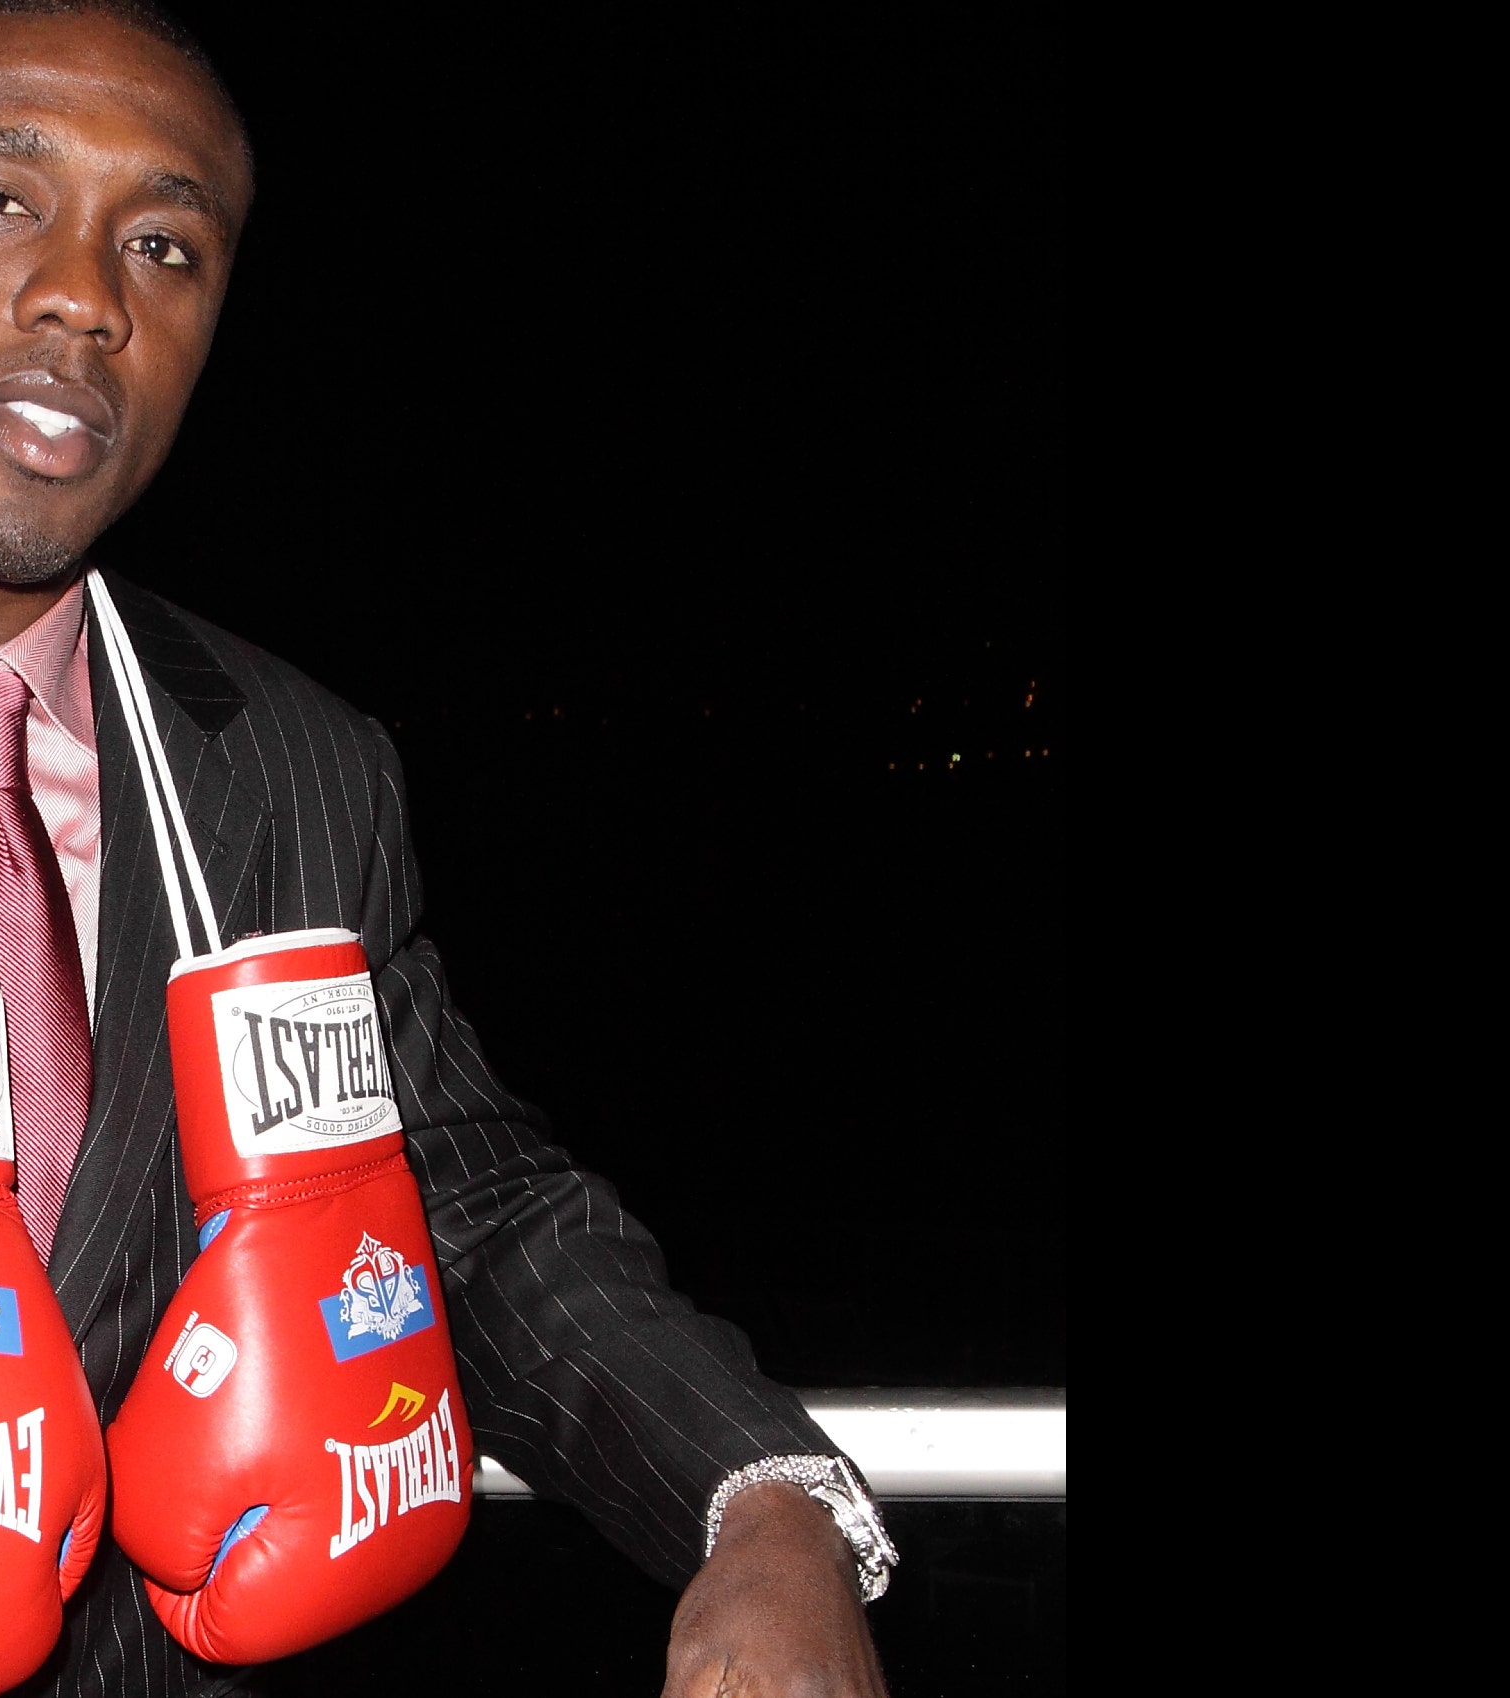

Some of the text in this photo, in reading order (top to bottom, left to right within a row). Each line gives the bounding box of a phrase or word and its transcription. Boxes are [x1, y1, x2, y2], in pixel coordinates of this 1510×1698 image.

[301, 996, 317, 1007] NY
[327, 1006, 345, 1016] 1910
[244, 1011, 392, 1136] VERLAST
[306, 1107, 386, 1133] SPORTING GOODS
[330, 1388, 461, 1560] EVERLAST
